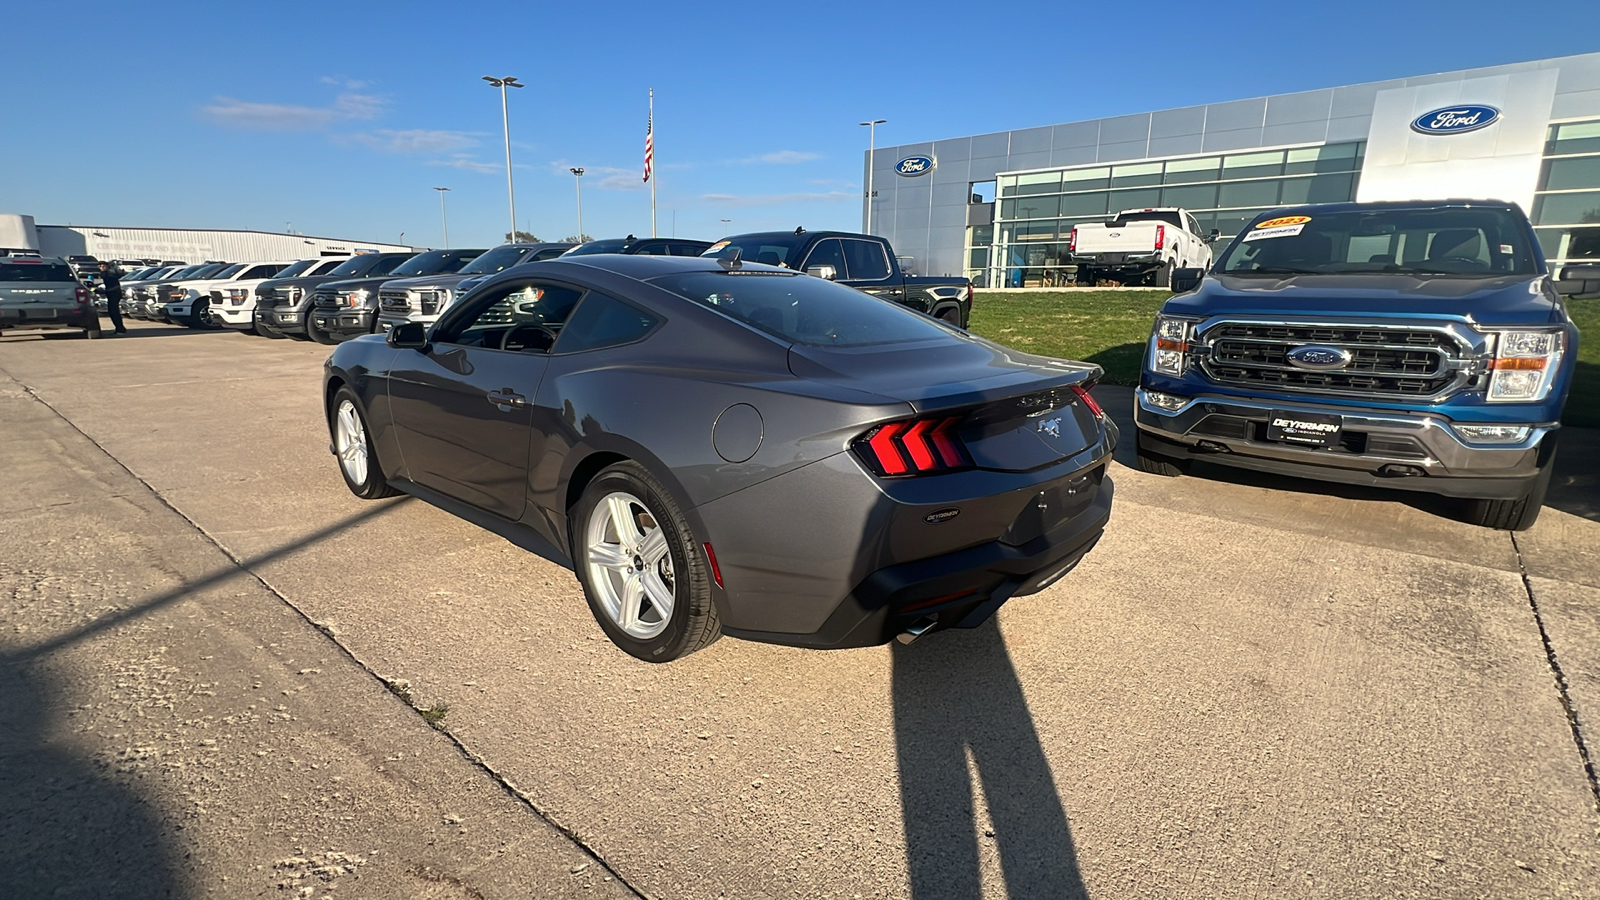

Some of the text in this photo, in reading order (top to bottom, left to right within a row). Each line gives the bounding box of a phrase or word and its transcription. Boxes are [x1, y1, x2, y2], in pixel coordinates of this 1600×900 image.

[1430, 110, 1482, 129] Ford
[900, 159, 925, 173] Ford
[1260, 217, 1306, 227] 2023
[133, 243, 153, 252] PARTS
[172, 245, 196, 253] SERVICE
[1302, 351, 1334, 363] Ford
[1272, 418, 1340, 433] DEYARMAN
